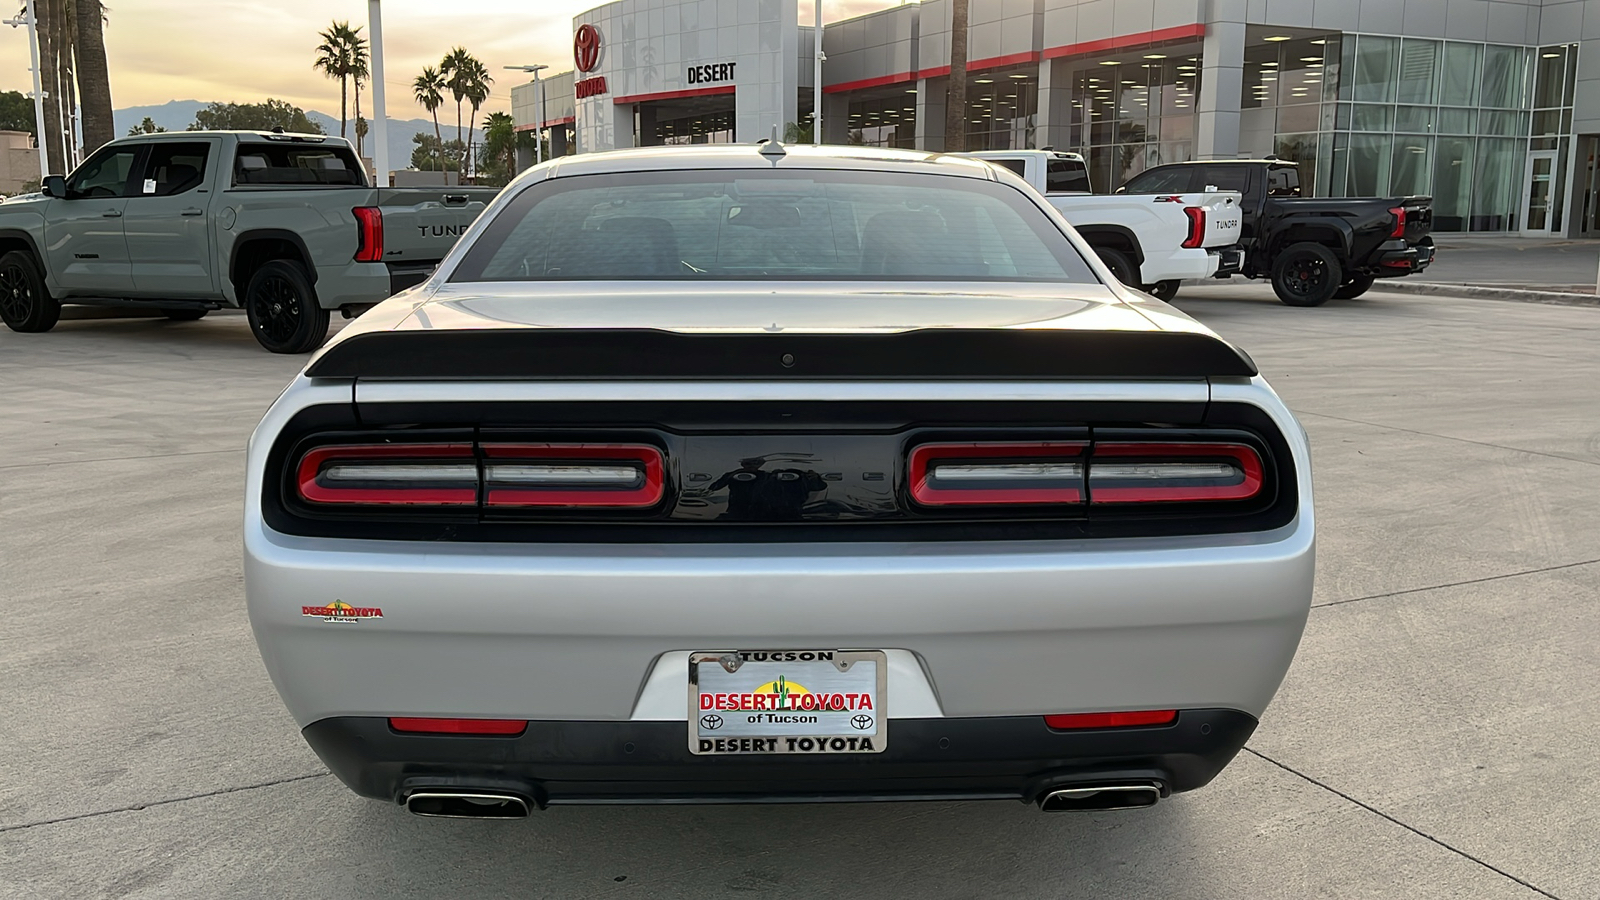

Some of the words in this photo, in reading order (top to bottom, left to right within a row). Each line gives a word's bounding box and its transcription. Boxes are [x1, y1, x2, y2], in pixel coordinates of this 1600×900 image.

[688, 62, 736, 84] DESERT
[575, 76, 607, 99] TOYOTA
[1216, 220, 1237, 230] TUNDRA
[689, 472, 885, 481] DODGE
[302, 606, 338, 616] DESERT
[343, 607, 383, 617] TOYOTA
[741, 652, 833, 661] TUCSON
[700, 693, 780, 711] DESERT
[787, 693, 873, 711] TOYOTA
[747, 714, 763, 724] of
[765, 714, 818, 724] Tucson
[700, 739, 778, 752] DESERT
[787, 738, 874, 752] TOYOTA
